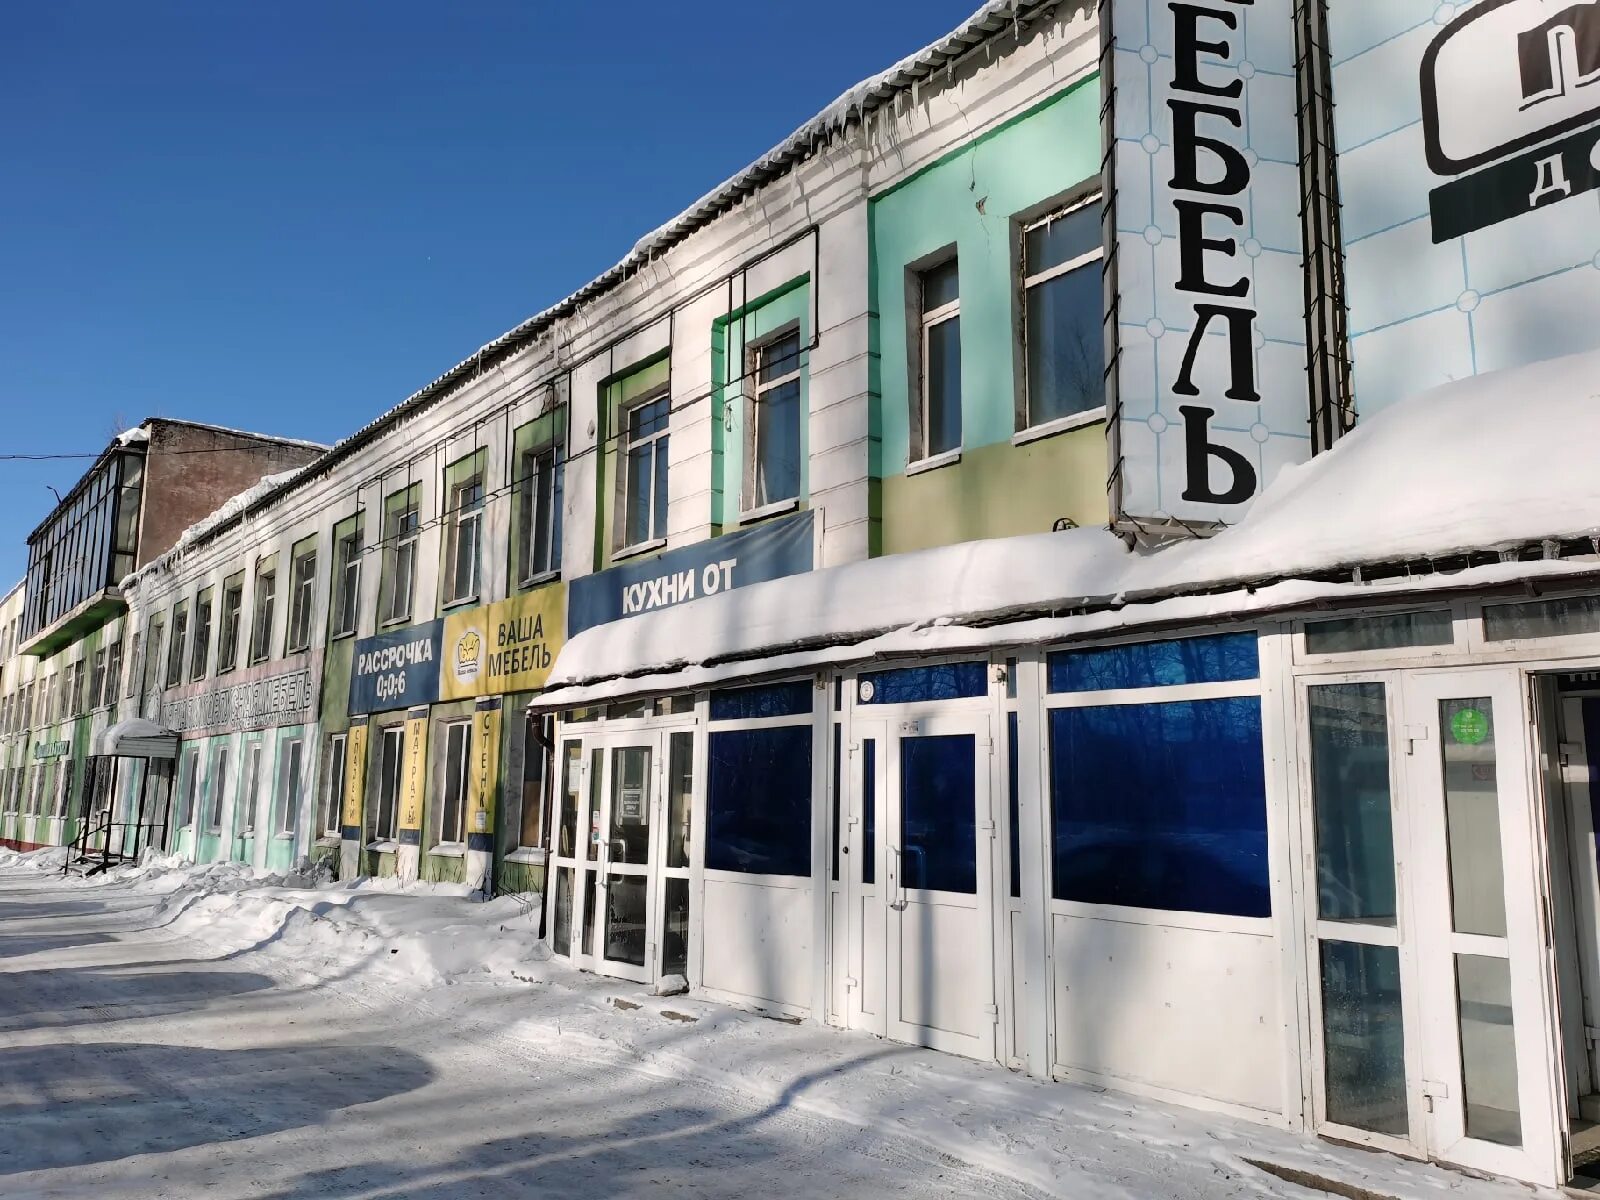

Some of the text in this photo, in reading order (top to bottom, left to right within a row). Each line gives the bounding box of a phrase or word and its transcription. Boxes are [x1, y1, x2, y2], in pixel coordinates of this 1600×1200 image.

[1165, 0, 1261, 505] ЕБЕЛЬ
[622, 558, 737, 615] КУХНИ ОТ
[497, 613, 544, 647] ВАША
[357, 638, 433, 676] РАССРОЧКА
[488, 642, 552, 677] МЕБЕЛЬ
[479, 713, 490, 830] СТЕНК
